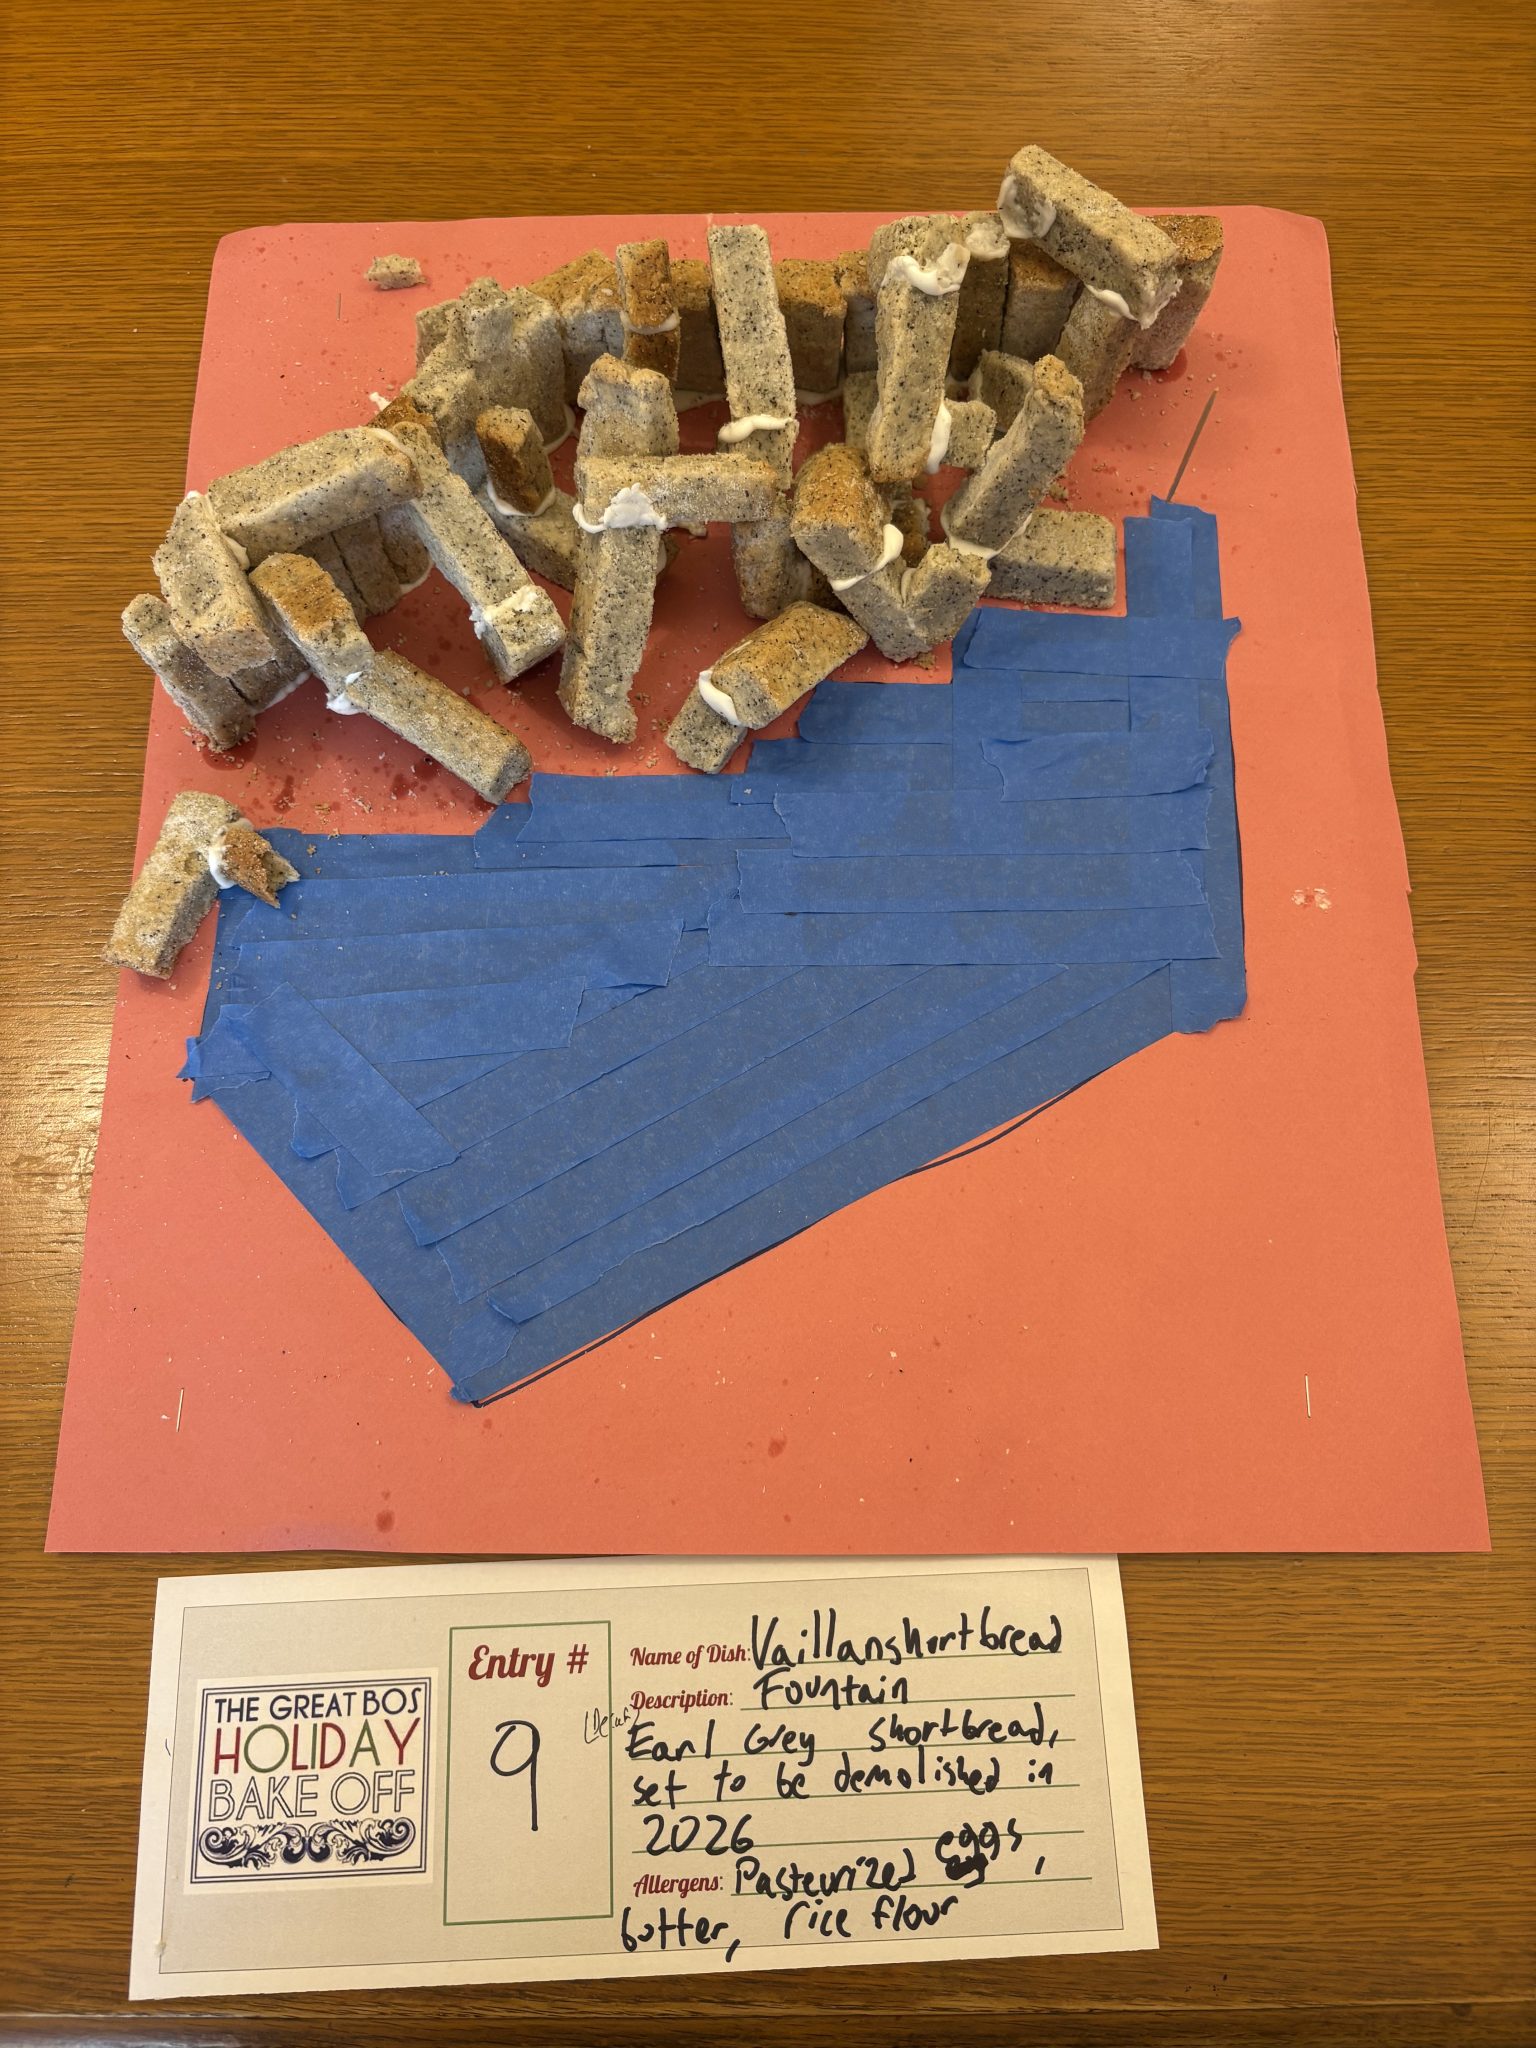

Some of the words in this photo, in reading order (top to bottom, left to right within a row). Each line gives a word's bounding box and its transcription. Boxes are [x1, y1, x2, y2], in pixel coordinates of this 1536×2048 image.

[630, 1646, 682, 1666] Name
[685, 1644, 705, 1669] of
[706, 1643, 751, 1663] Dish:
[752, 1605, 1062, 1670] Vaillanshortbread
[468, 1644, 555, 1688] Entry
[566, 1643, 589, 1674] #
[753, 1666, 908, 1710] Fountain
[214, 1696, 260, 1723] THE
[269, 1691, 357, 1720] GREAT
[362, 1687, 422, 1716] BOS
[631, 1688, 733, 1713] Description:
[213, 1717, 421, 1775] HOLIDAY
[625, 1719, 716, 1762] Earl
[744, 1722, 815, 1767] Grey
[208, 1774, 319, 1822] BAKE
[330, 1769, 415, 1815] OFF
[489, 1719, 541, 1832] 9
[633, 1769, 688, 1810] set
[713, 1759, 747, 1802] to
[776, 1761, 811, 1799] be
[834, 1744, 1000, 1795] demolished
[1028, 1759, 1053, 1785] in
[642, 1813, 755, 1857] 2026
[633, 1874, 724, 1899] Allergens:
[735, 1847, 917, 1901] Pasteurized
[784, 1899, 851, 1939] rice
[872, 1894, 959, 1931] flour
